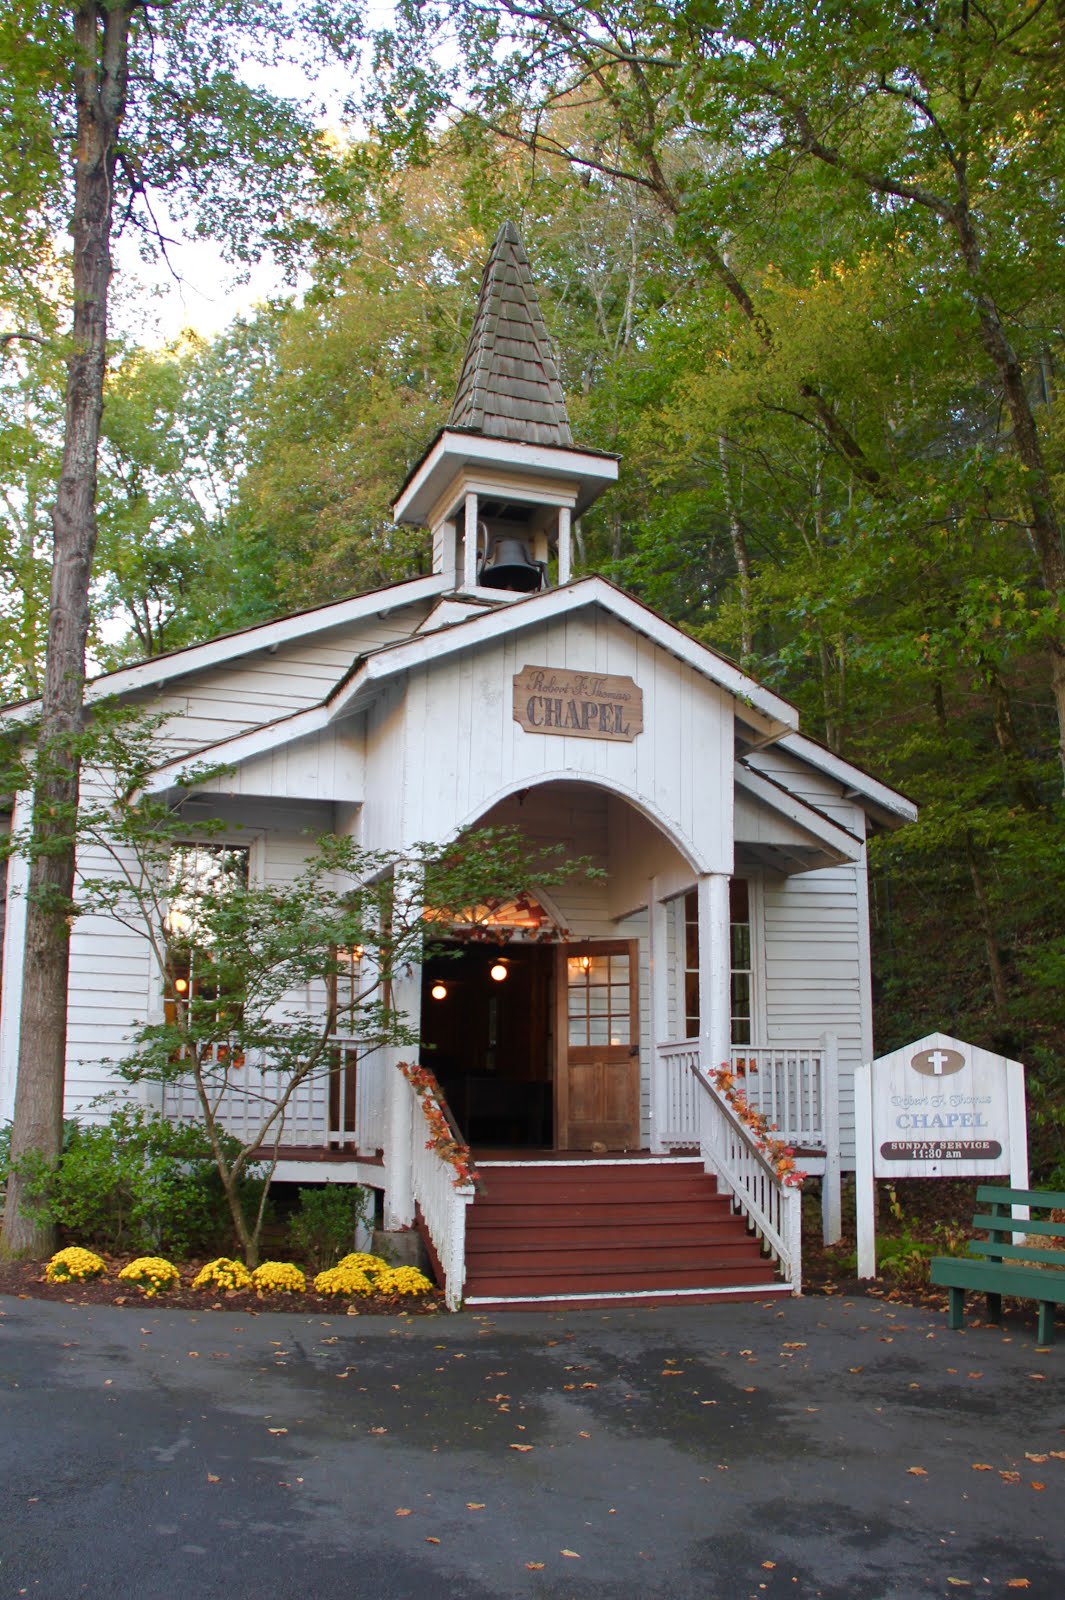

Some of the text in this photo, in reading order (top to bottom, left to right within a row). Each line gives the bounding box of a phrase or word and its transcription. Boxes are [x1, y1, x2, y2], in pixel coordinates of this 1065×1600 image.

[526, 670, 570, 694] Robert
[585, 677, 631, 702] Thomas
[526, 696, 631, 736] CHAPEL
[949, 1094, 993, 1107] Thomas
[895, 1112, 989, 1129] CHAPEL
[891, 1141, 990, 1150] SUNDAY SERVICE
[911, 1148, 962, 1159] 11:30 am
